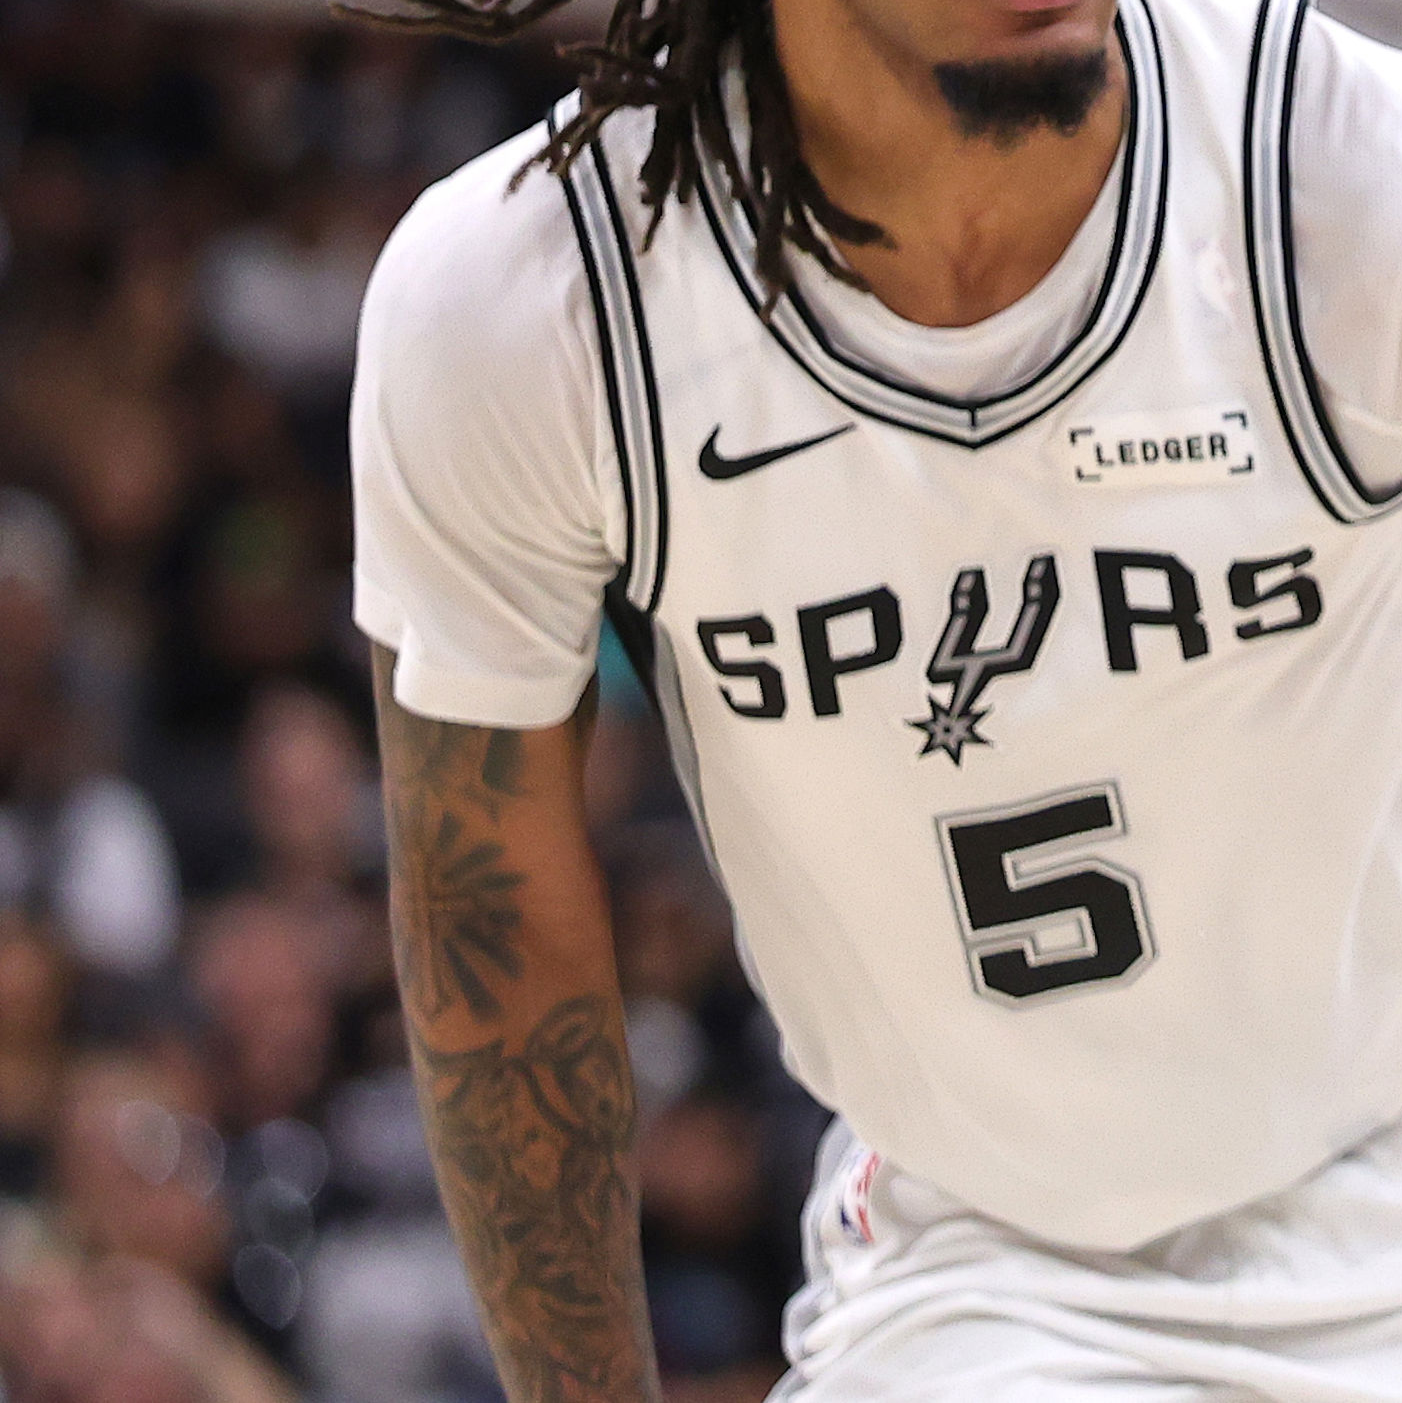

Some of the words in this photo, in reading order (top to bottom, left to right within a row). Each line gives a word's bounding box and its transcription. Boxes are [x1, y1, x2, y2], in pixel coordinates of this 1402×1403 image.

[1095, 433, 1230, 466] LEDGER
[698, 547, 1323, 766] SPURS
[934, 778, 1158, 1011] 5
